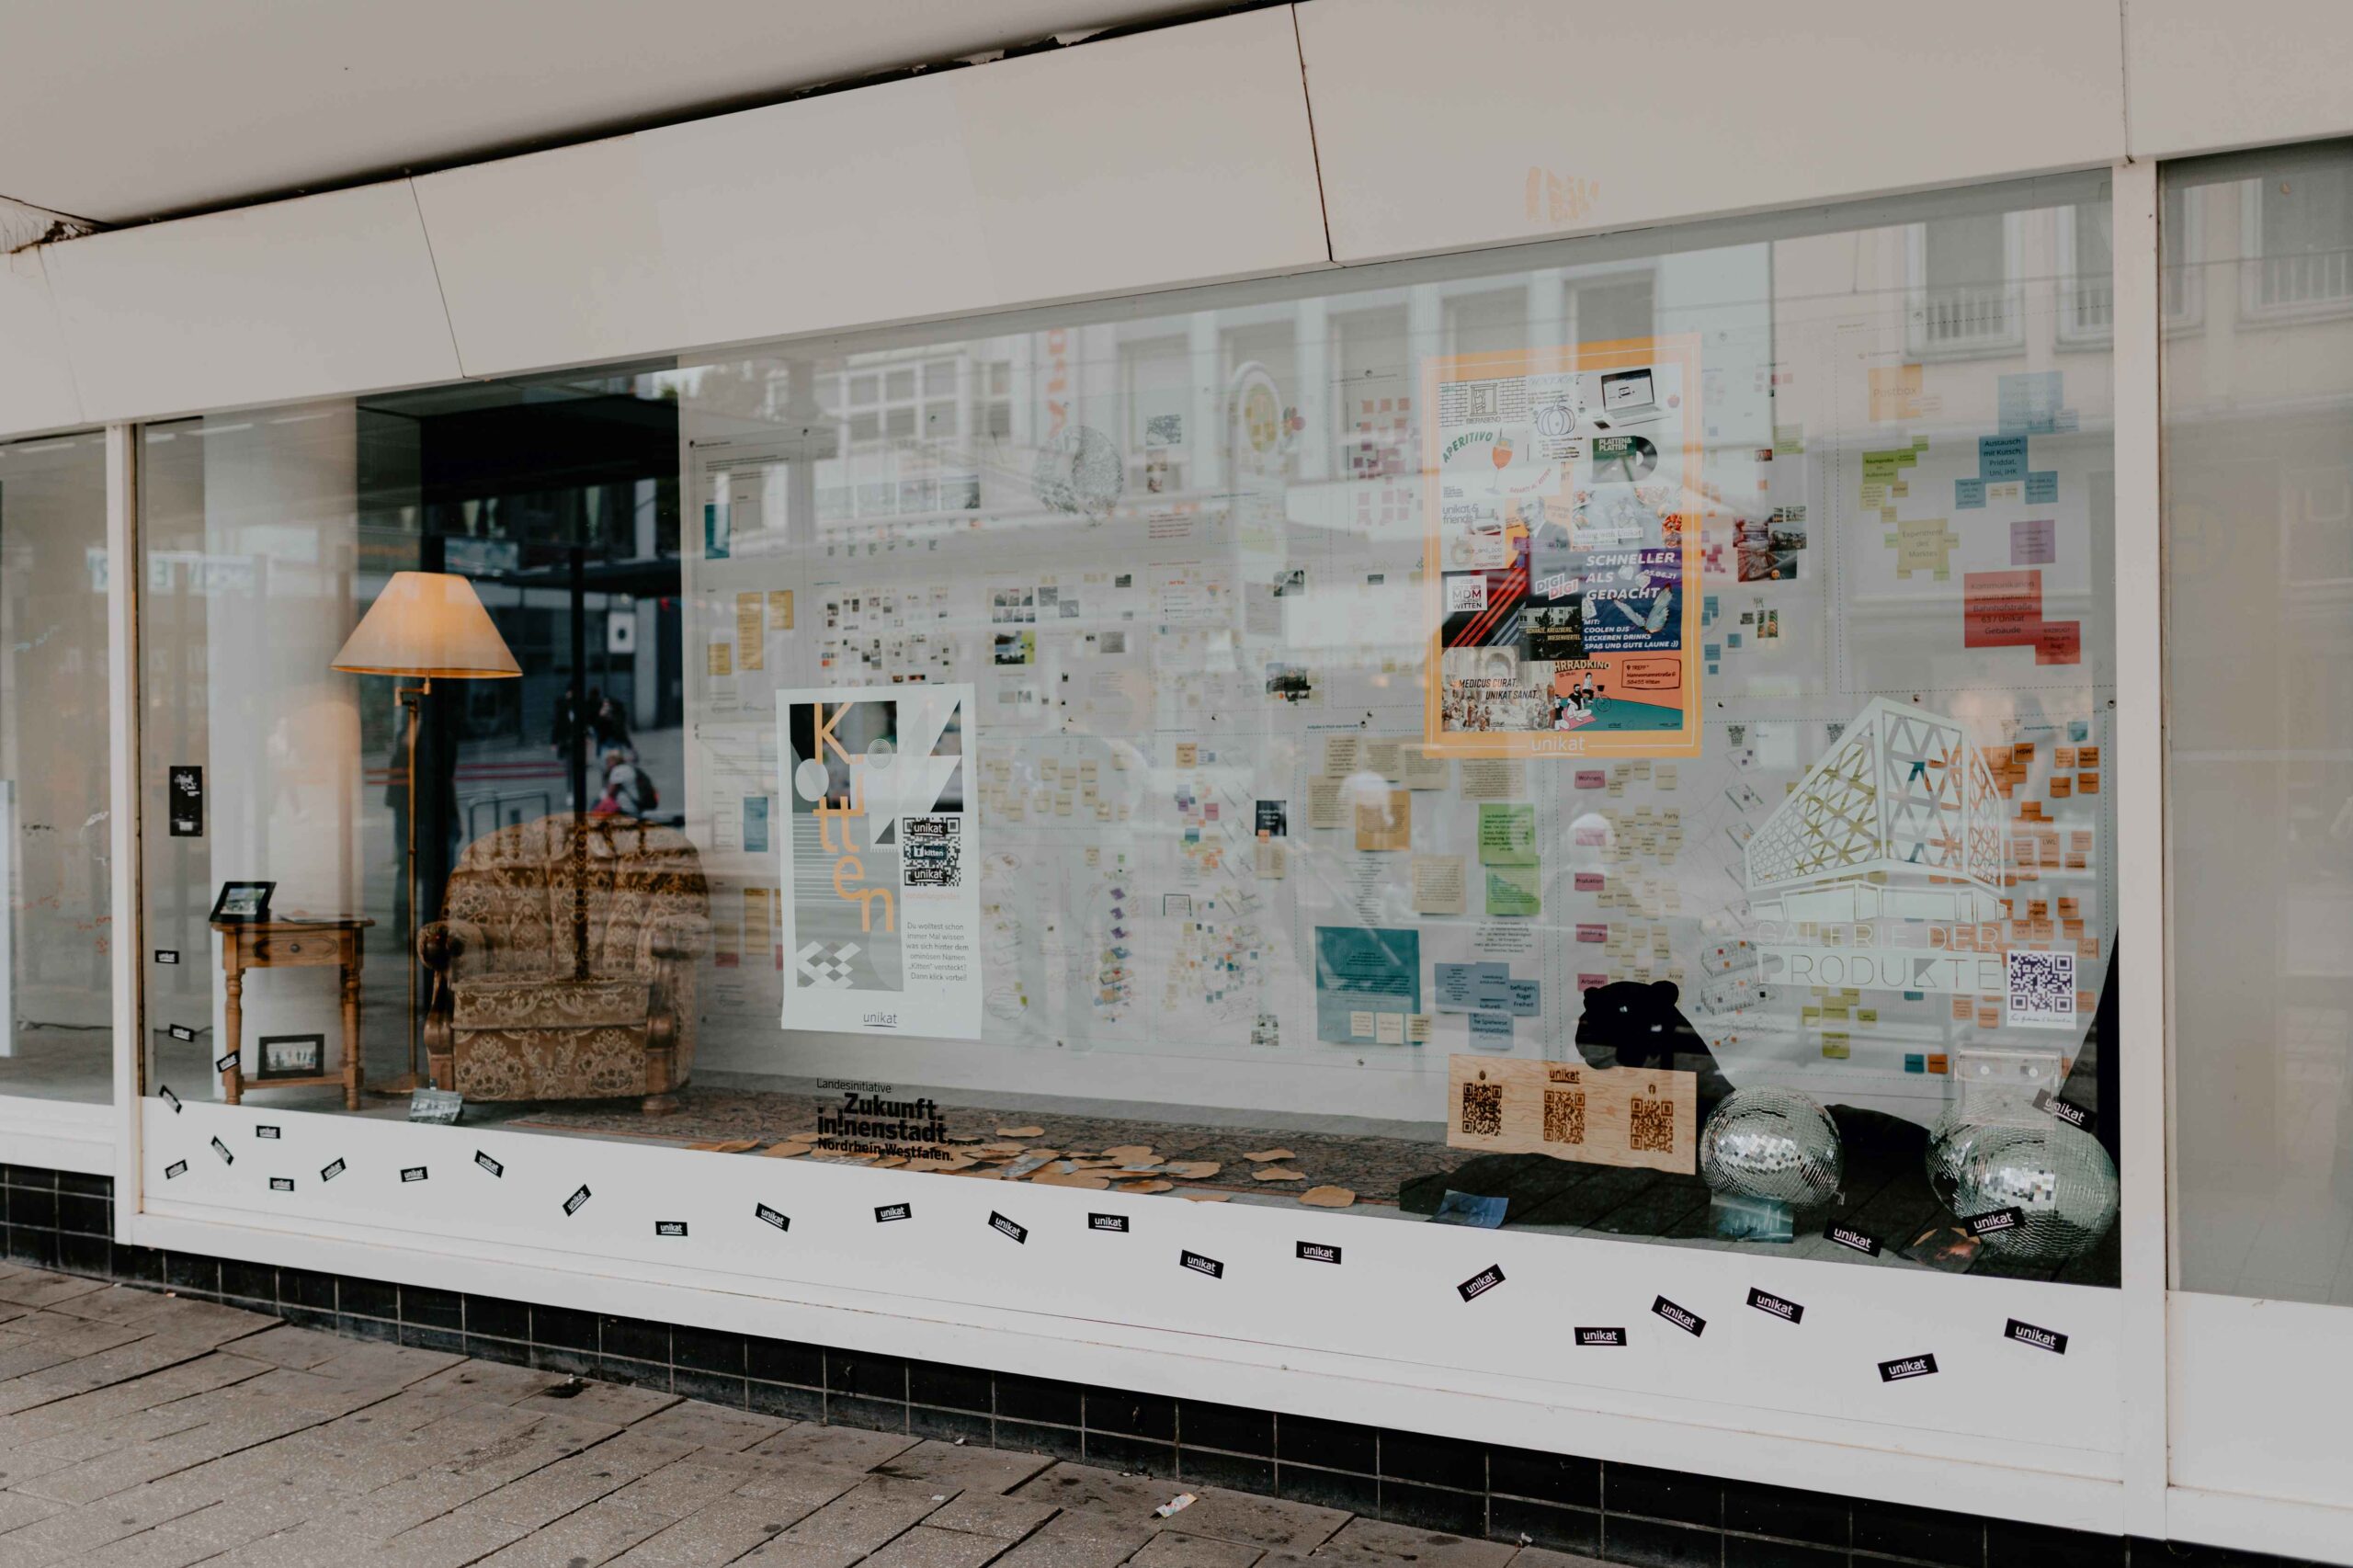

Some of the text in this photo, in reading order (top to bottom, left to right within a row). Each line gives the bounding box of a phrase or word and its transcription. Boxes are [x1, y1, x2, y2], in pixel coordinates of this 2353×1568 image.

[1442, 431, 1494, 463] APERITIVO
[1985, 438, 2022, 448] Austausch
[1442, 504, 1471, 515] unikat
[1586, 552, 1675, 566] SCHNELLER
[1537, 575, 1565, 592] DIGI
[1586, 572, 1614, 584] ALS
[1453, 590, 1482, 598] MDM
[1551, 582, 1578, 598] DIGI
[1586, 586, 1660, 600] GEDACHT
[1459, 679, 1491, 688] MEDICUS
[1485, 691, 1512, 700] UNIKAT
[1531, 735, 1586, 753] unikat
[914, 823, 943, 834] unikat
[915, 869, 943, 880] unikat
[1756, 922, 1999, 952] GALERIE DER
[911, 971, 928, 980] Dann
[1761, 952, 2001, 990] PRODUKTE
[863, 1011, 898, 1023] unikat
[1549, 1068, 1580, 1081] unikat
[816, 1078, 892, 1094] Landesinitiative
[844, 1092, 944, 1121] Zukunft.
[2045, 1096, 2086, 1123] unikat
[817, 1138, 954, 1162] Nordrhein-Westfalen.
[479, 1155, 500, 1173] unikat
[567, 1189, 586, 1210] unikat
[761, 1208, 785, 1225] unikat
[881, 1206, 905, 1218] unikat
[660, 1224, 683, 1233] unikat
[995, 1217, 1021, 1237] unikat
[1095, 1217, 1122, 1227] unikat
[1973, 1211, 2014, 1230] unikat
[1833, 1227, 1872, 1248] unikat
[1303, 1245, 1334, 1258] unikat
[1188, 1256, 1216, 1272] unikat
[1466, 1271, 1496, 1294] unikat
[1757, 1293, 1794, 1316] unikat
[1661, 1301, 1697, 1328] unikat
[1583, 1330, 1618, 1341] unikat
[2015, 1325, 2057, 1346] unikat
[1888, 1358, 1927, 1376] unikat
